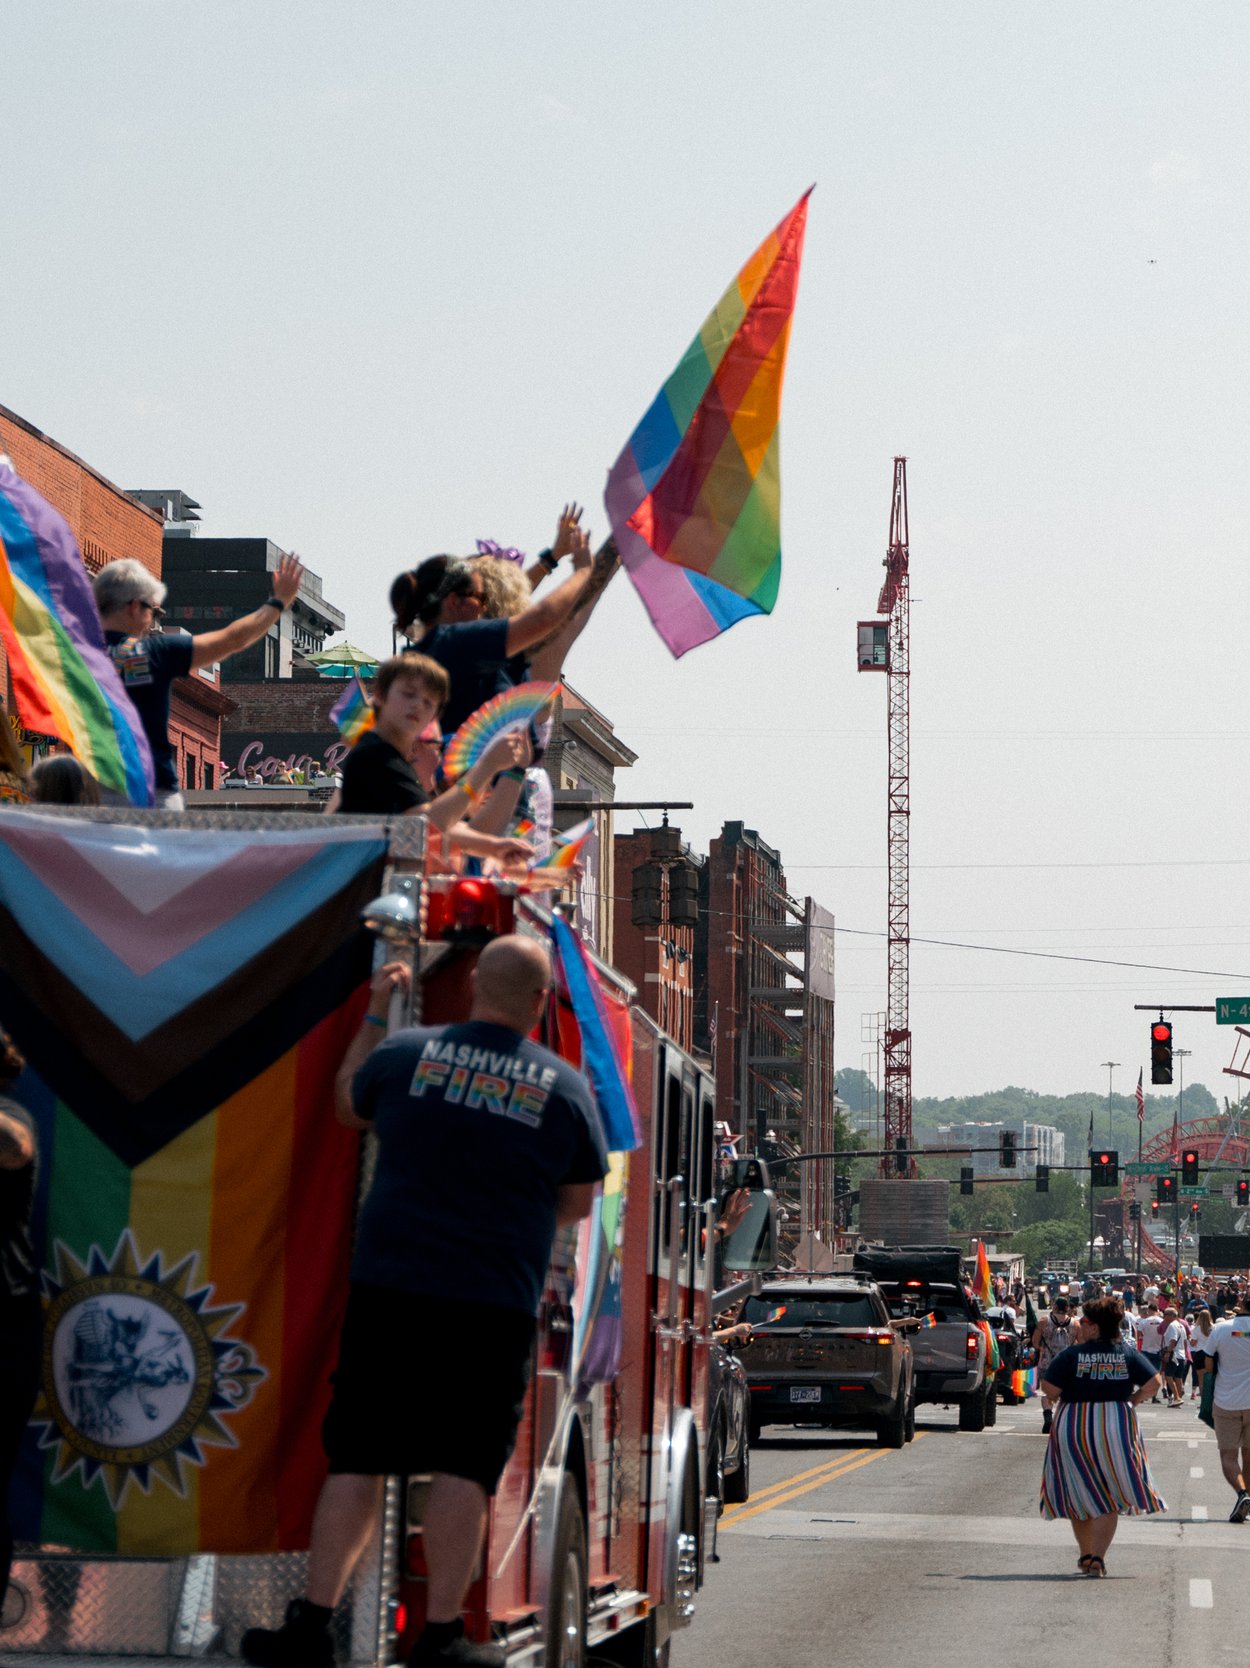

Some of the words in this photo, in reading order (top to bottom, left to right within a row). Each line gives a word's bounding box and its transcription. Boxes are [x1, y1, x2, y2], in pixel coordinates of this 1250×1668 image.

[420, 1038, 557, 1089] NASHVILLE
[408, 1060, 549, 1130] FIRE
[1075, 1362, 1129, 1380] FIRE
[1078, 1353, 1126, 1363] NASHVILLE
